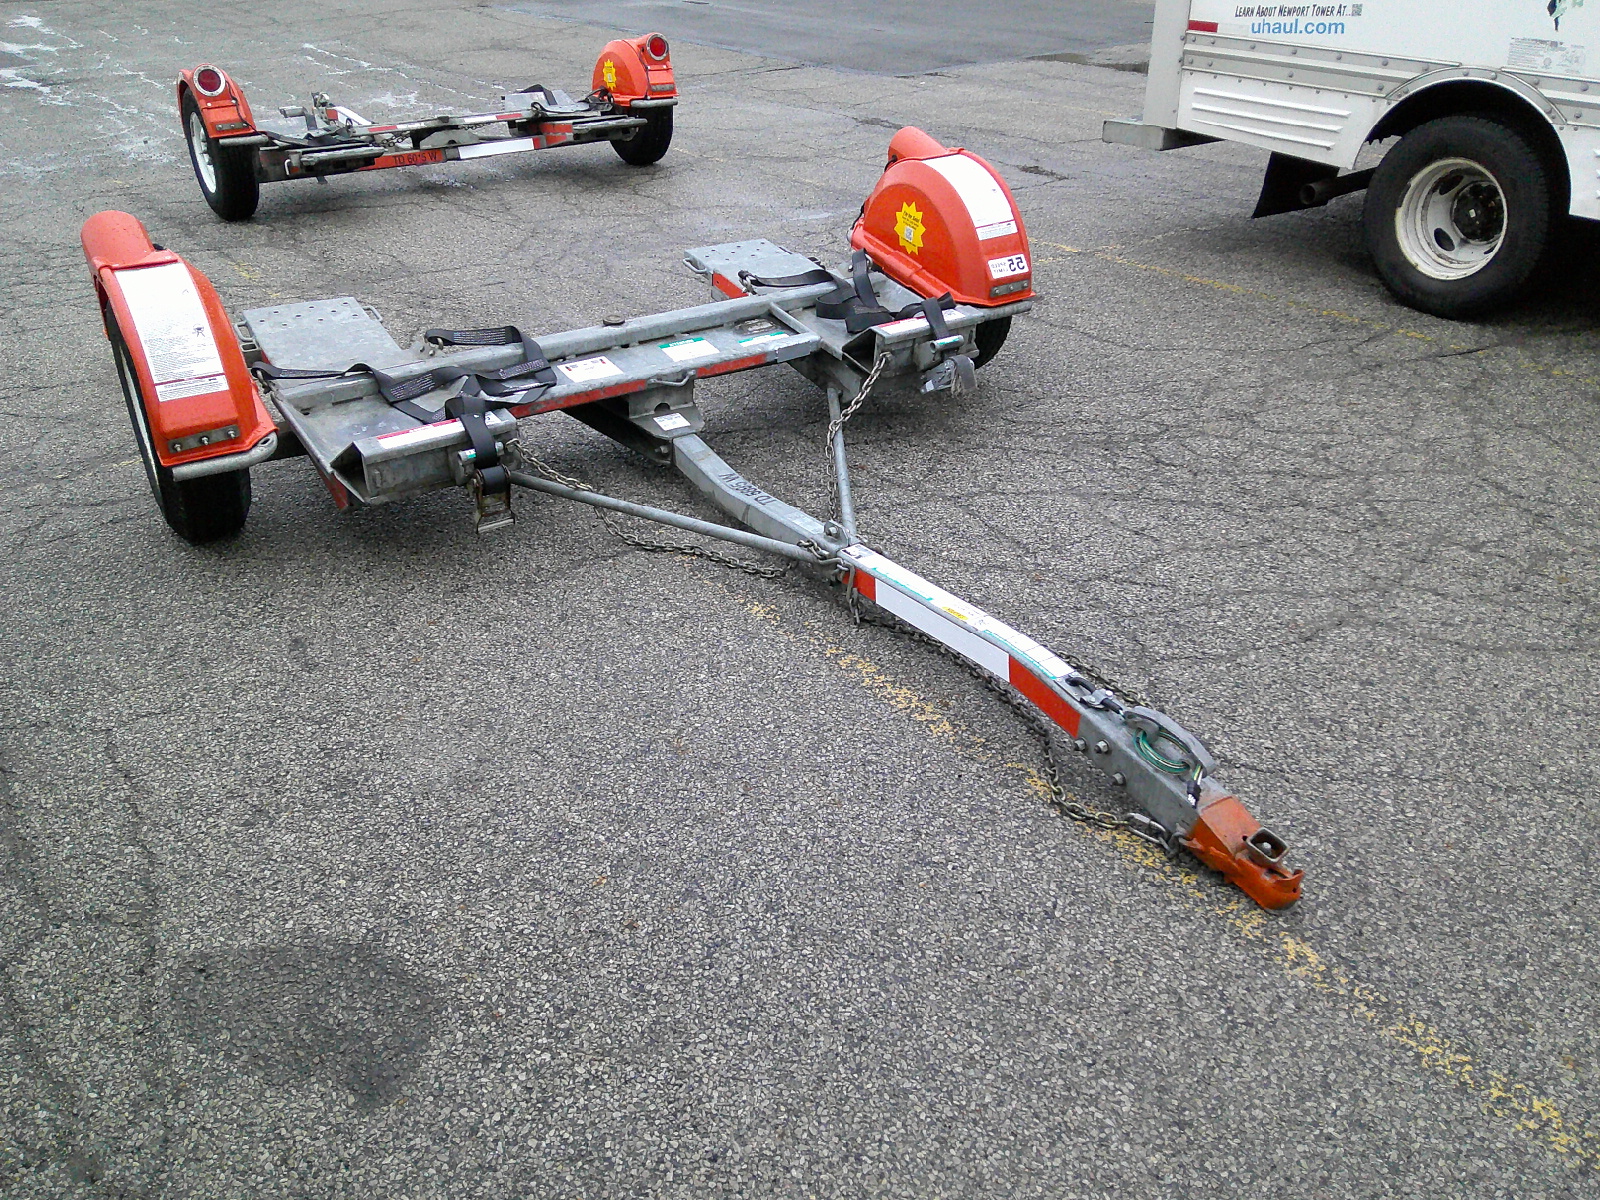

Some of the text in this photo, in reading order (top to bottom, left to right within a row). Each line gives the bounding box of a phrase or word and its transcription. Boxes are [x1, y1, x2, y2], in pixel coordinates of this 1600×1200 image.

[1235, 5, 1254, 17] LEARN
[1256, 5, 1277, 17] ABOUT
[1278, 4, 1310, 17] NEWPORT
[1311, 4, 1335, 17] TOWER
[1251, 18, 1345, 34] uhaul.com
[428, 151, 437, 161] W
